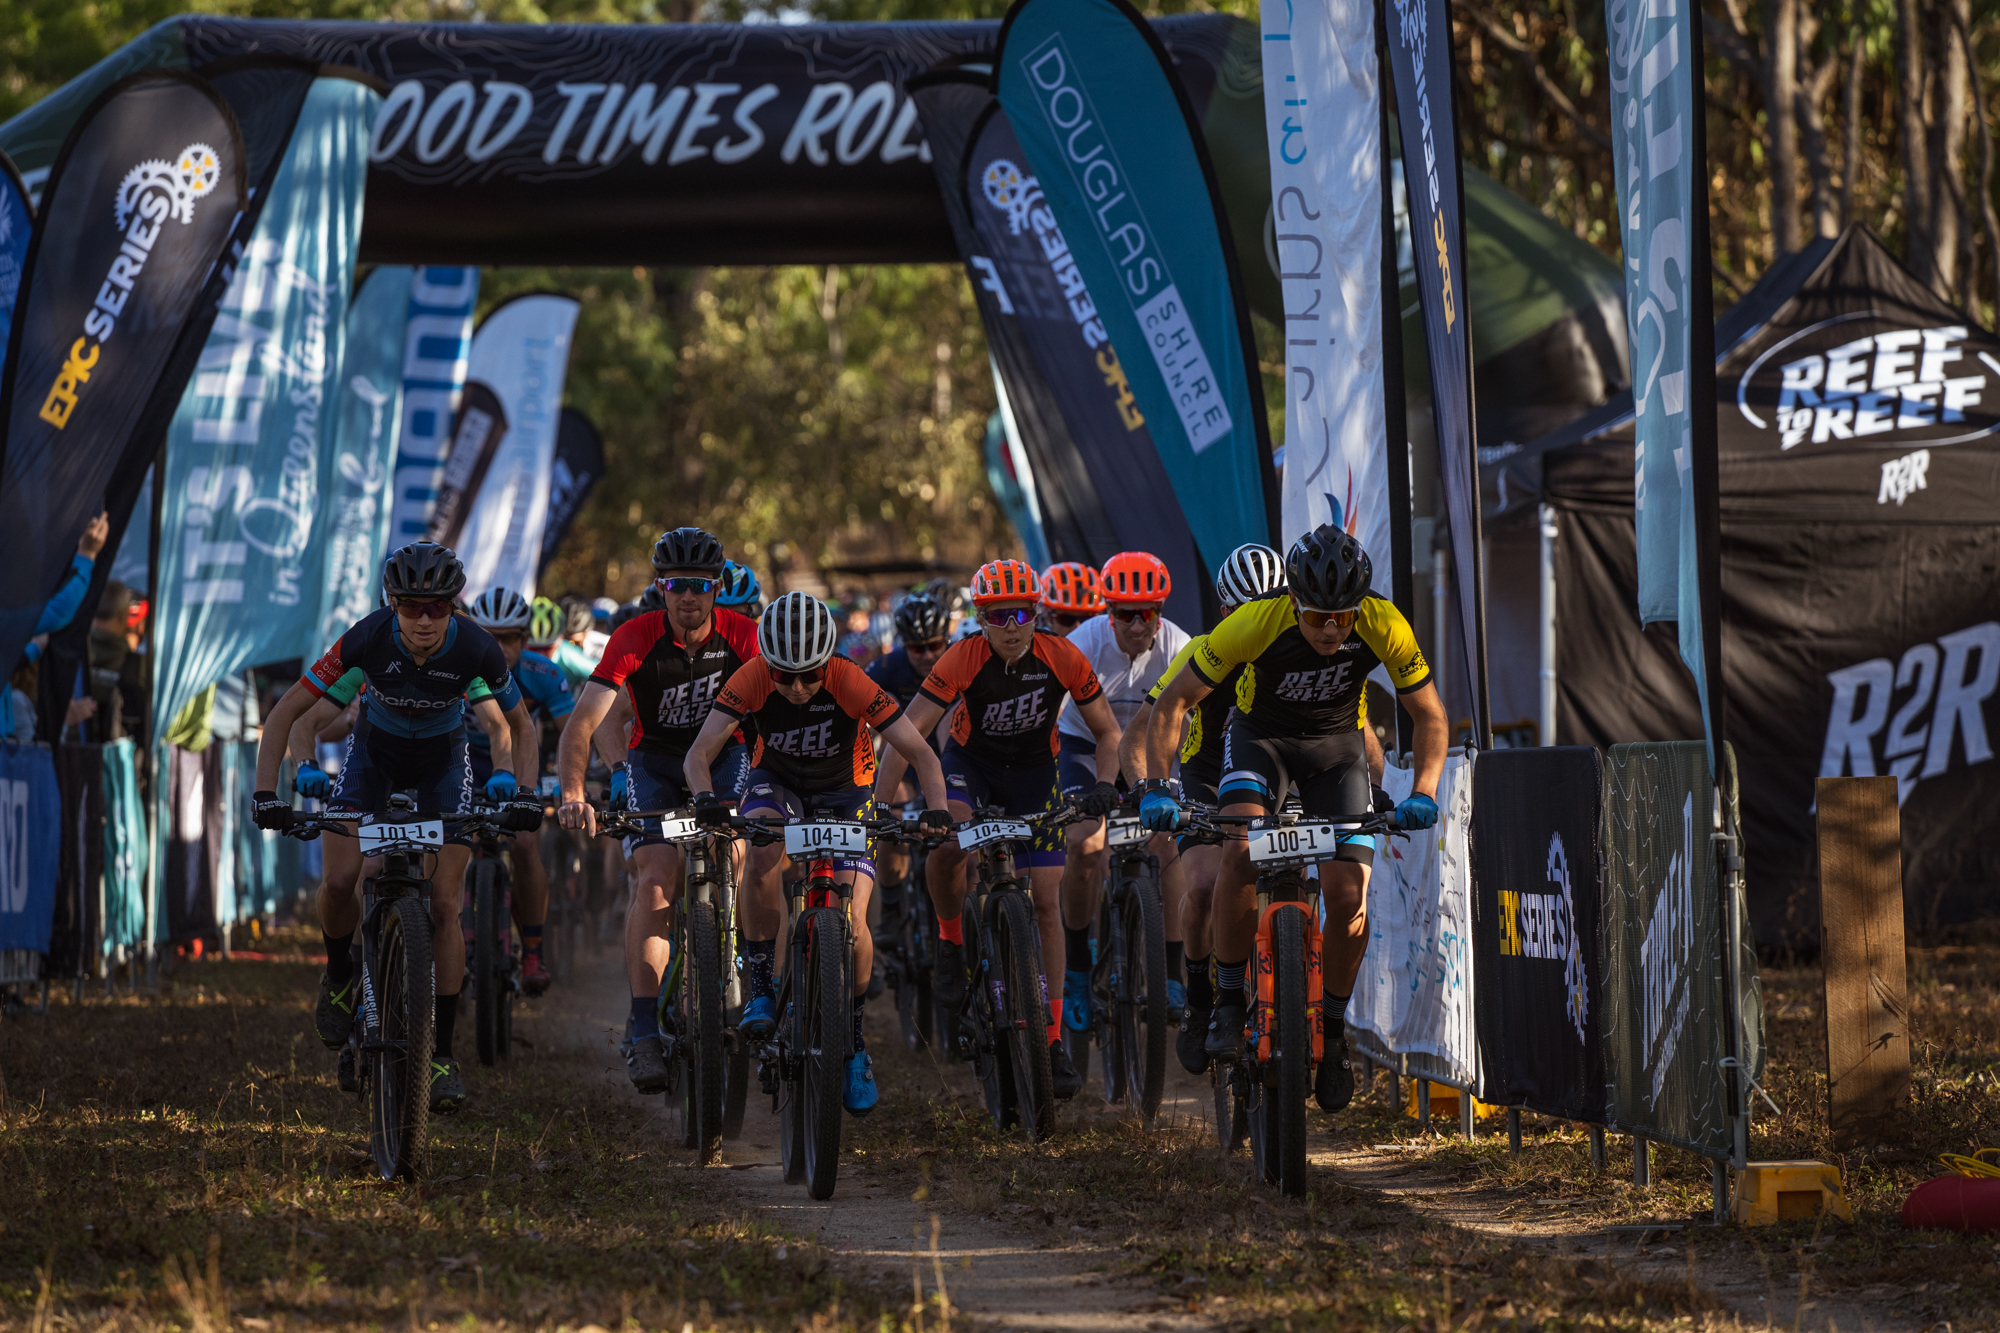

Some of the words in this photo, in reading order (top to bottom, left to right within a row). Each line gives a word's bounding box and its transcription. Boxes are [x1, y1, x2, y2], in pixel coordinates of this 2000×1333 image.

[543, 82, 779, 165] TIMES
[1031, 47, 1161, 296] DOUGLAS
[39, 336, 100, 431] EPIC
[84, 190, 171, 343] SERIES
[1145, 314, 1202, 437] COUNCIL
[1160, 300, 1224, 428] SHIRE
[1776, 325, 1968, 414] REEF
[1811, 375, 1986, 443] REEF
[1877, 449, 1930, 504] R2R
[659, 670, 722, 709] REEF
[1022, 672, 1048, 681] Santini
[1278, 661, 1353, 689] REEF
[809, 702, 836, 712] Santini
[866, 696, 885, 715] EPIC
[983, 686, 1045, 722] REEF
[1808, 620, 2000, 816] R2R
[767, 718, 833, 751] REEF
[377, 825, 425, 843] 101-1
[801, 827, 849, 847] 104-1
[973, 823, 1018, 841] 104-2
[1266, 828, 1318, 854] 100-1
[1497, 889, 1522, 957] EPIC
[1520, 892, 1567, 961] SERIES
